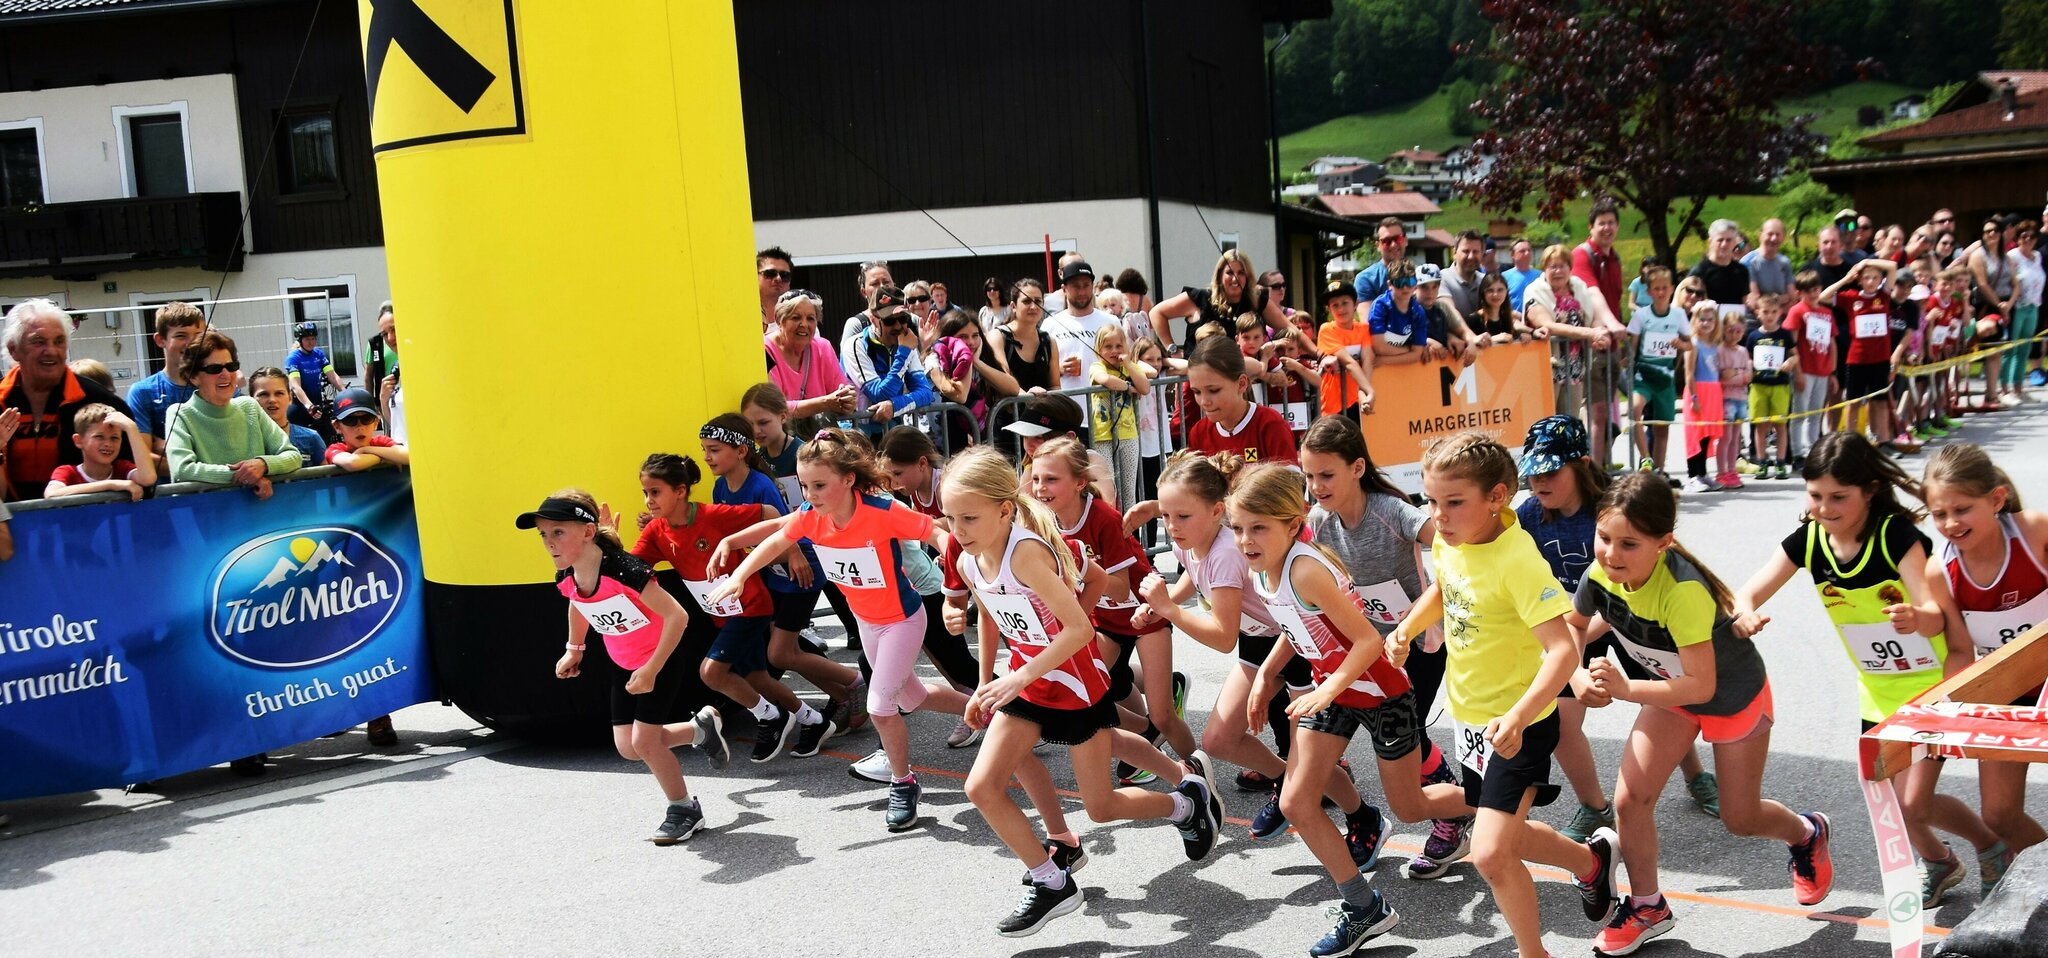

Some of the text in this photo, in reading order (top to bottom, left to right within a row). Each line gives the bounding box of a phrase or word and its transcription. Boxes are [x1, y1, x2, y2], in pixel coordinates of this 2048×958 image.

[1408, 407, 1512, 436] MARGREITER
[835, 561, 860, 576] 74
[225, 571, 393, 636] Tirol Milch
[592, 611, 628, 626] 302
[996, 610, 1028, 630] 106
[1871, 640, 1904, 659] 90
[1861, 660, 1887, 668] TLV
[0, 655, 128, 705] rnmilch
[245, 657, 408, 718] Ehrlich guat.
[1464, 728, 1485, 755] 98
